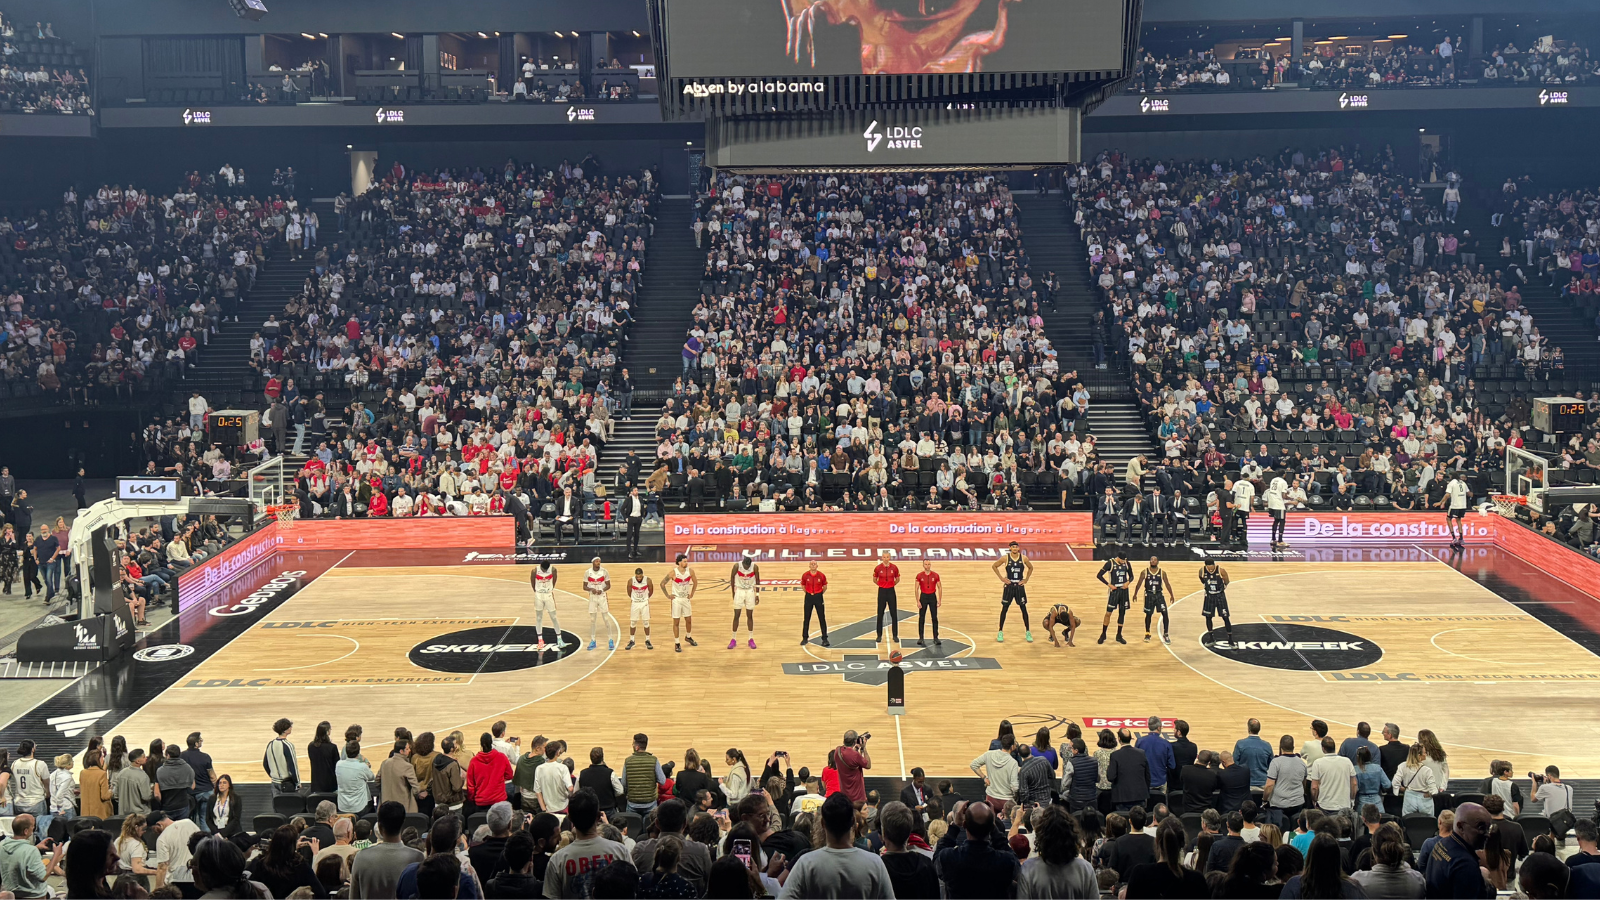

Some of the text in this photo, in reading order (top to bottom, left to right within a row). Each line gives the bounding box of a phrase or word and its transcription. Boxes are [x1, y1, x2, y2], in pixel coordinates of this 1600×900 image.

[683, 80, 824, 97] Absen by alabama
[887, 127, 922, 138] LDLC
[887, 140, 922, 149] ASVEL
[1560, 404, 1584, 414] 0:25
[218, 417, 242, 427] 0:25
[129, 485, 166, 493] KIA
[674, 525, 690, 535] De
[693, 524, 704, 535] la
[707, 524, 775, 535] construction
[779, 524, 787, 534] à
[889, 524, 905, 533] De
[909, 523, 919, 533] la
[922, 523, 992, 534] construction
[996, 523, 1003, 533] à
[1304, 517, 1335, 537] De
[1342, 516, 1362, 537] la
[205, 566, 218, 586] De
[220, 556, 229, 577] la
[261, 621, 338, 629] LDLC
[419, 643, 572, 653] SKWEEK
[1214, 640, 1364, 650] SKWEEK
[798, 660, 968, 672] LDLC ASVEL
[1331, 672, 1422, 681] LDLC
[183, 678, 271, 687] LDLC
[1092, 718, 1173, 727] Betcc
[20, 776, 26, 789] 6
[566, 854, 613, 876] OBEY
